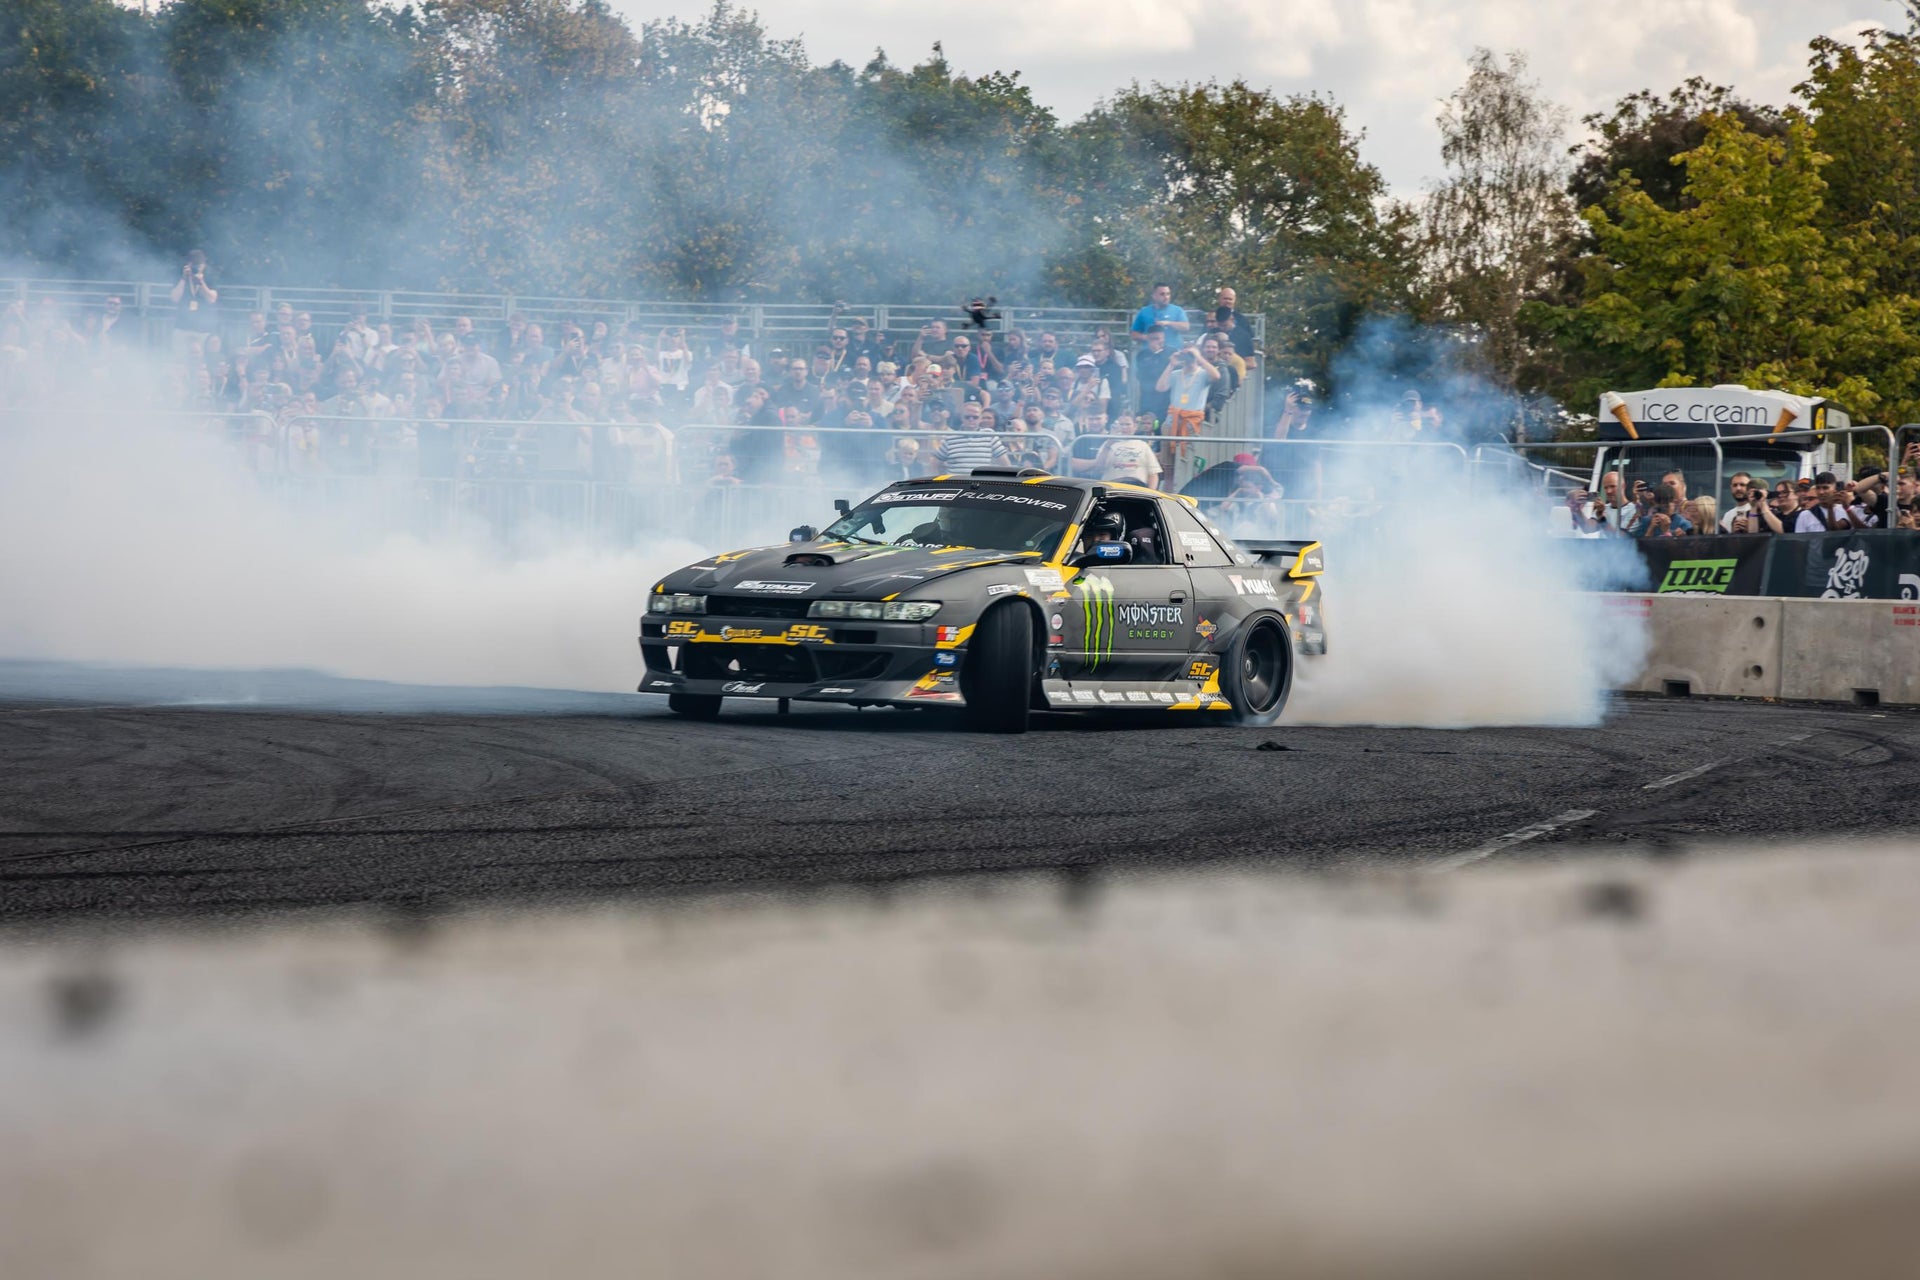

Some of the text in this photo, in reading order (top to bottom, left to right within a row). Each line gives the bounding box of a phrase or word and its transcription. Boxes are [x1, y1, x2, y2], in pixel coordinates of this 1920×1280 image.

[1641, 398, 1768, 424] ice cream
[959, 491, 1004, 501] FLUID
[1005, 495, 1067, 510] POWER
[1667, 566, 1736, 586] TIRE
[1129, 630, 1175, 638] ENERGY
